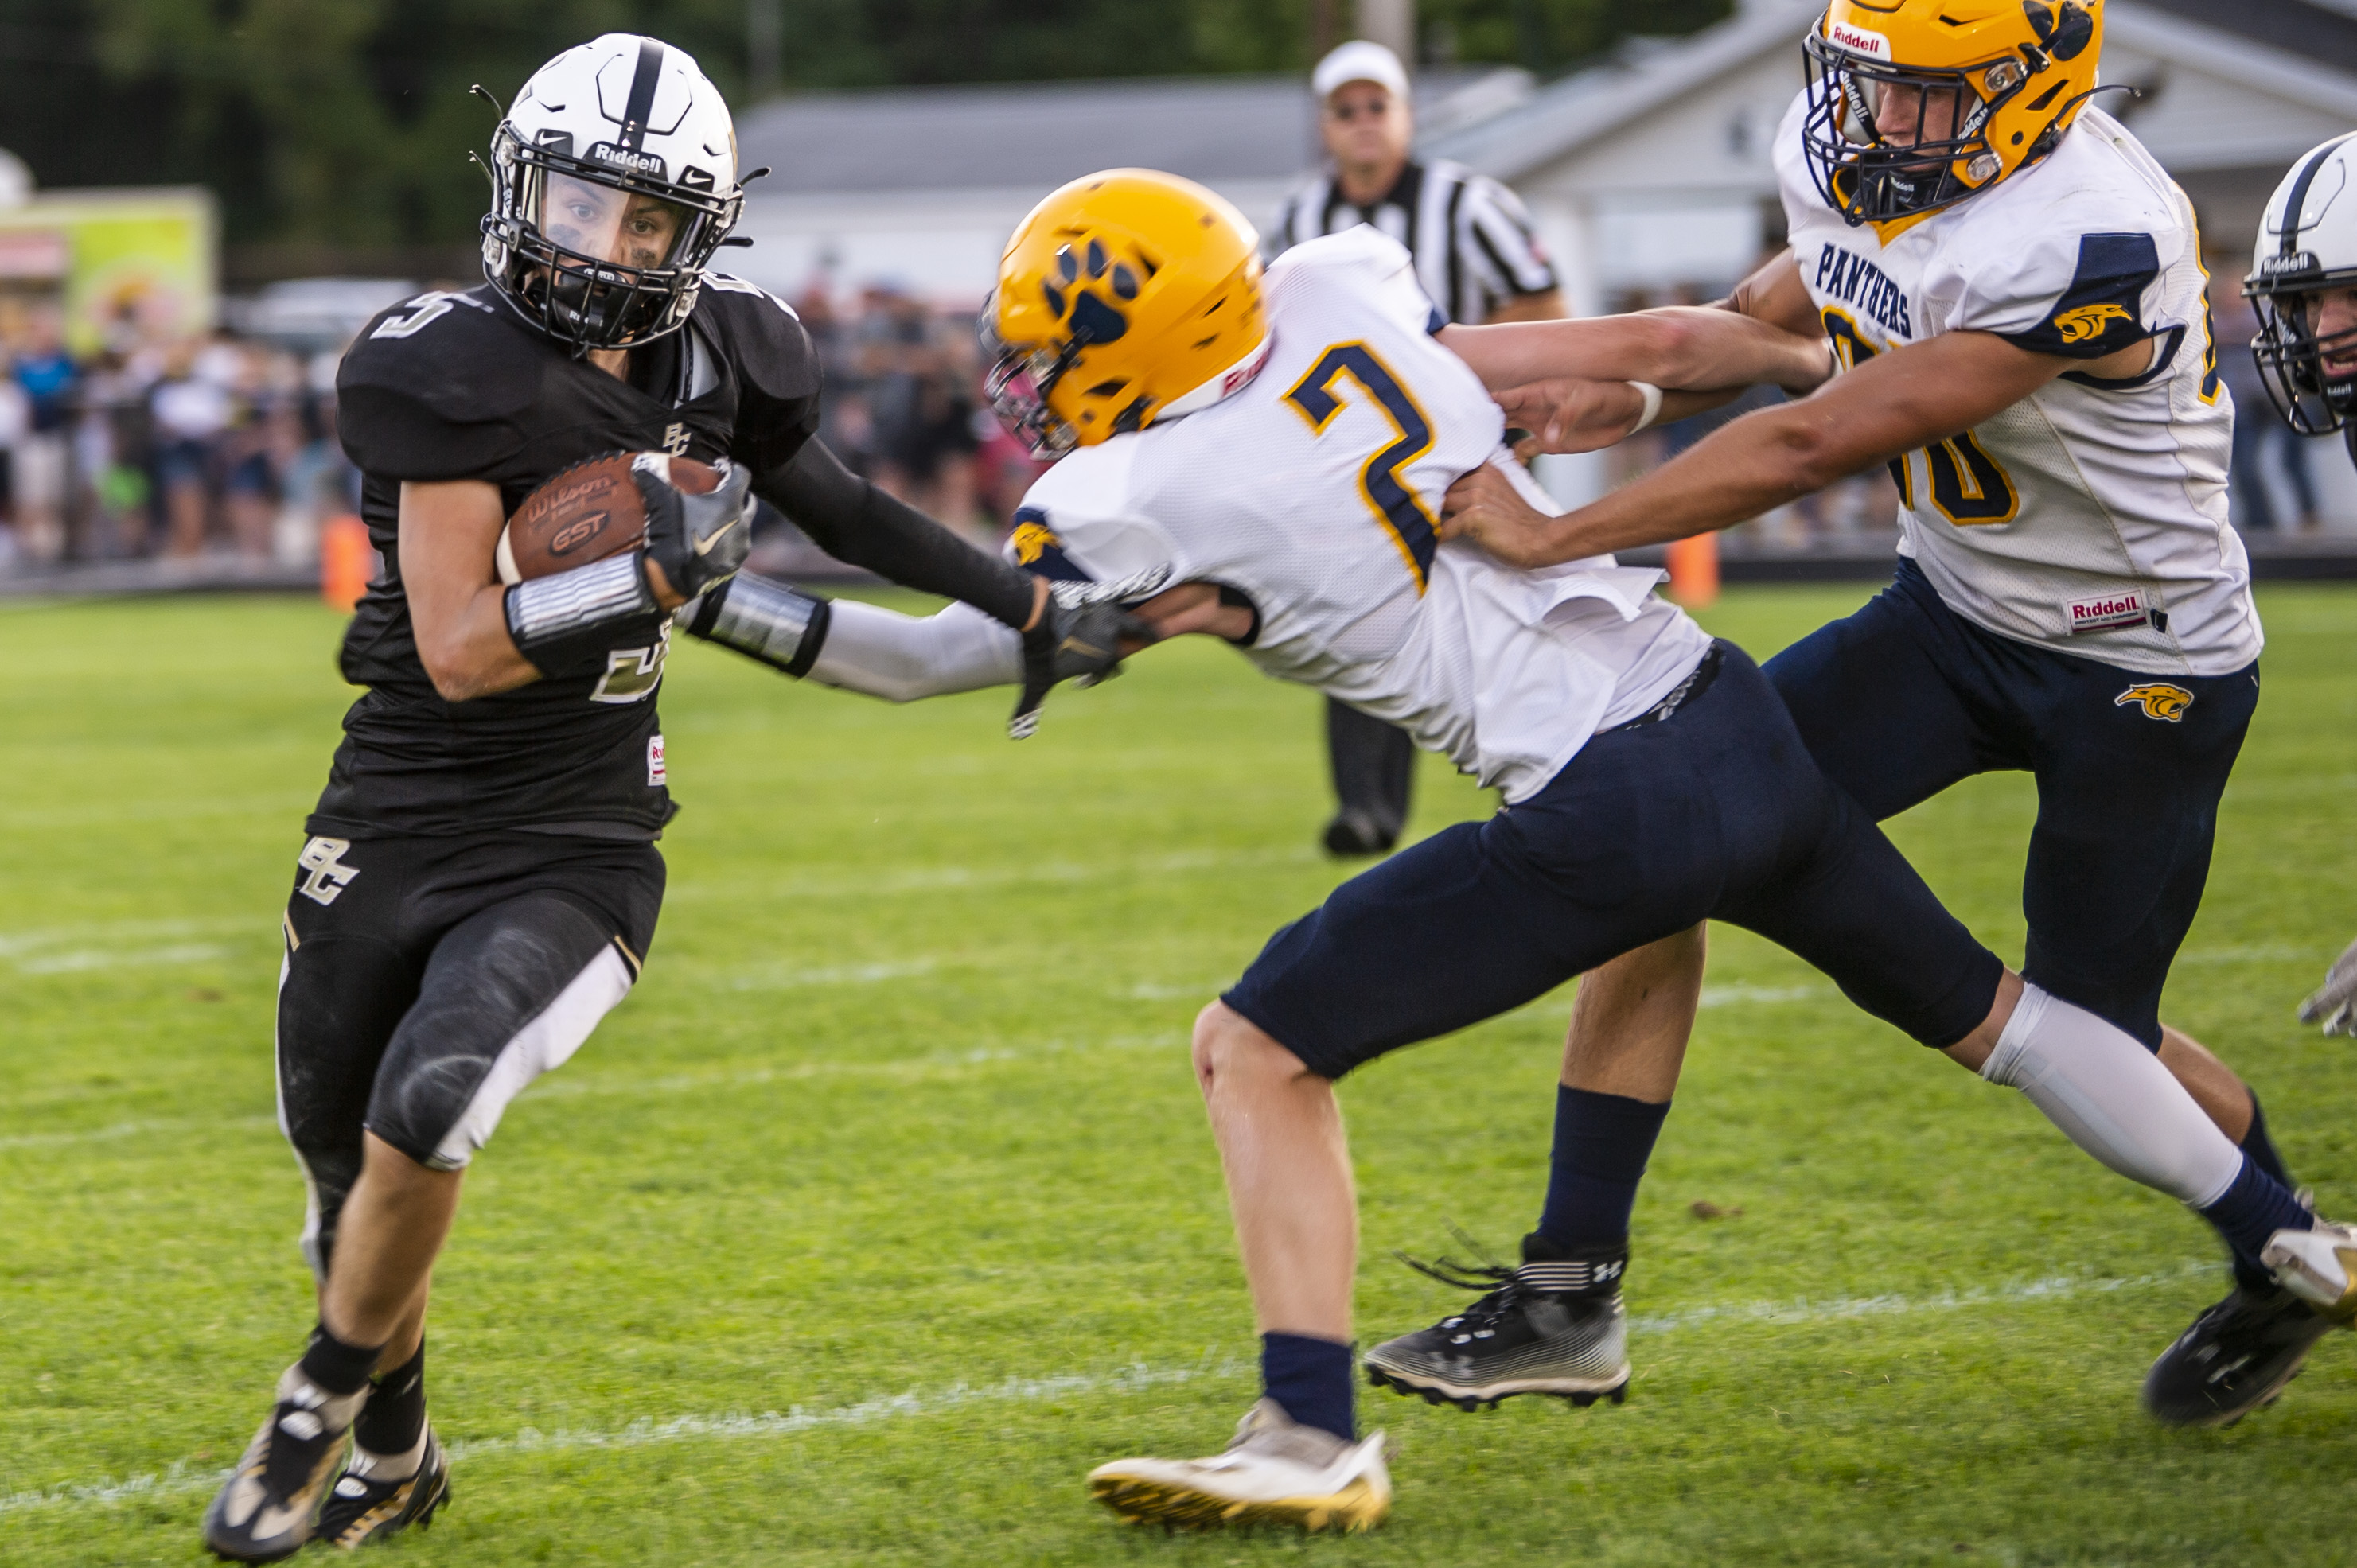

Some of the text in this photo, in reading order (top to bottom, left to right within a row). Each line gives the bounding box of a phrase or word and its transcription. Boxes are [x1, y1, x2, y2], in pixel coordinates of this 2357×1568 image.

[1833, 26, 1879, 52] Riddell
[594, 143, 661, 173] Riddell
[2263, 252, 2308, 274] Riddell
[1816, 242, 1912, 339] PANTHERS
[1281, 340, 1440, 598] 7
[528, 477, 611, 523] Wilson
[552, 512, 606, 552] GST
